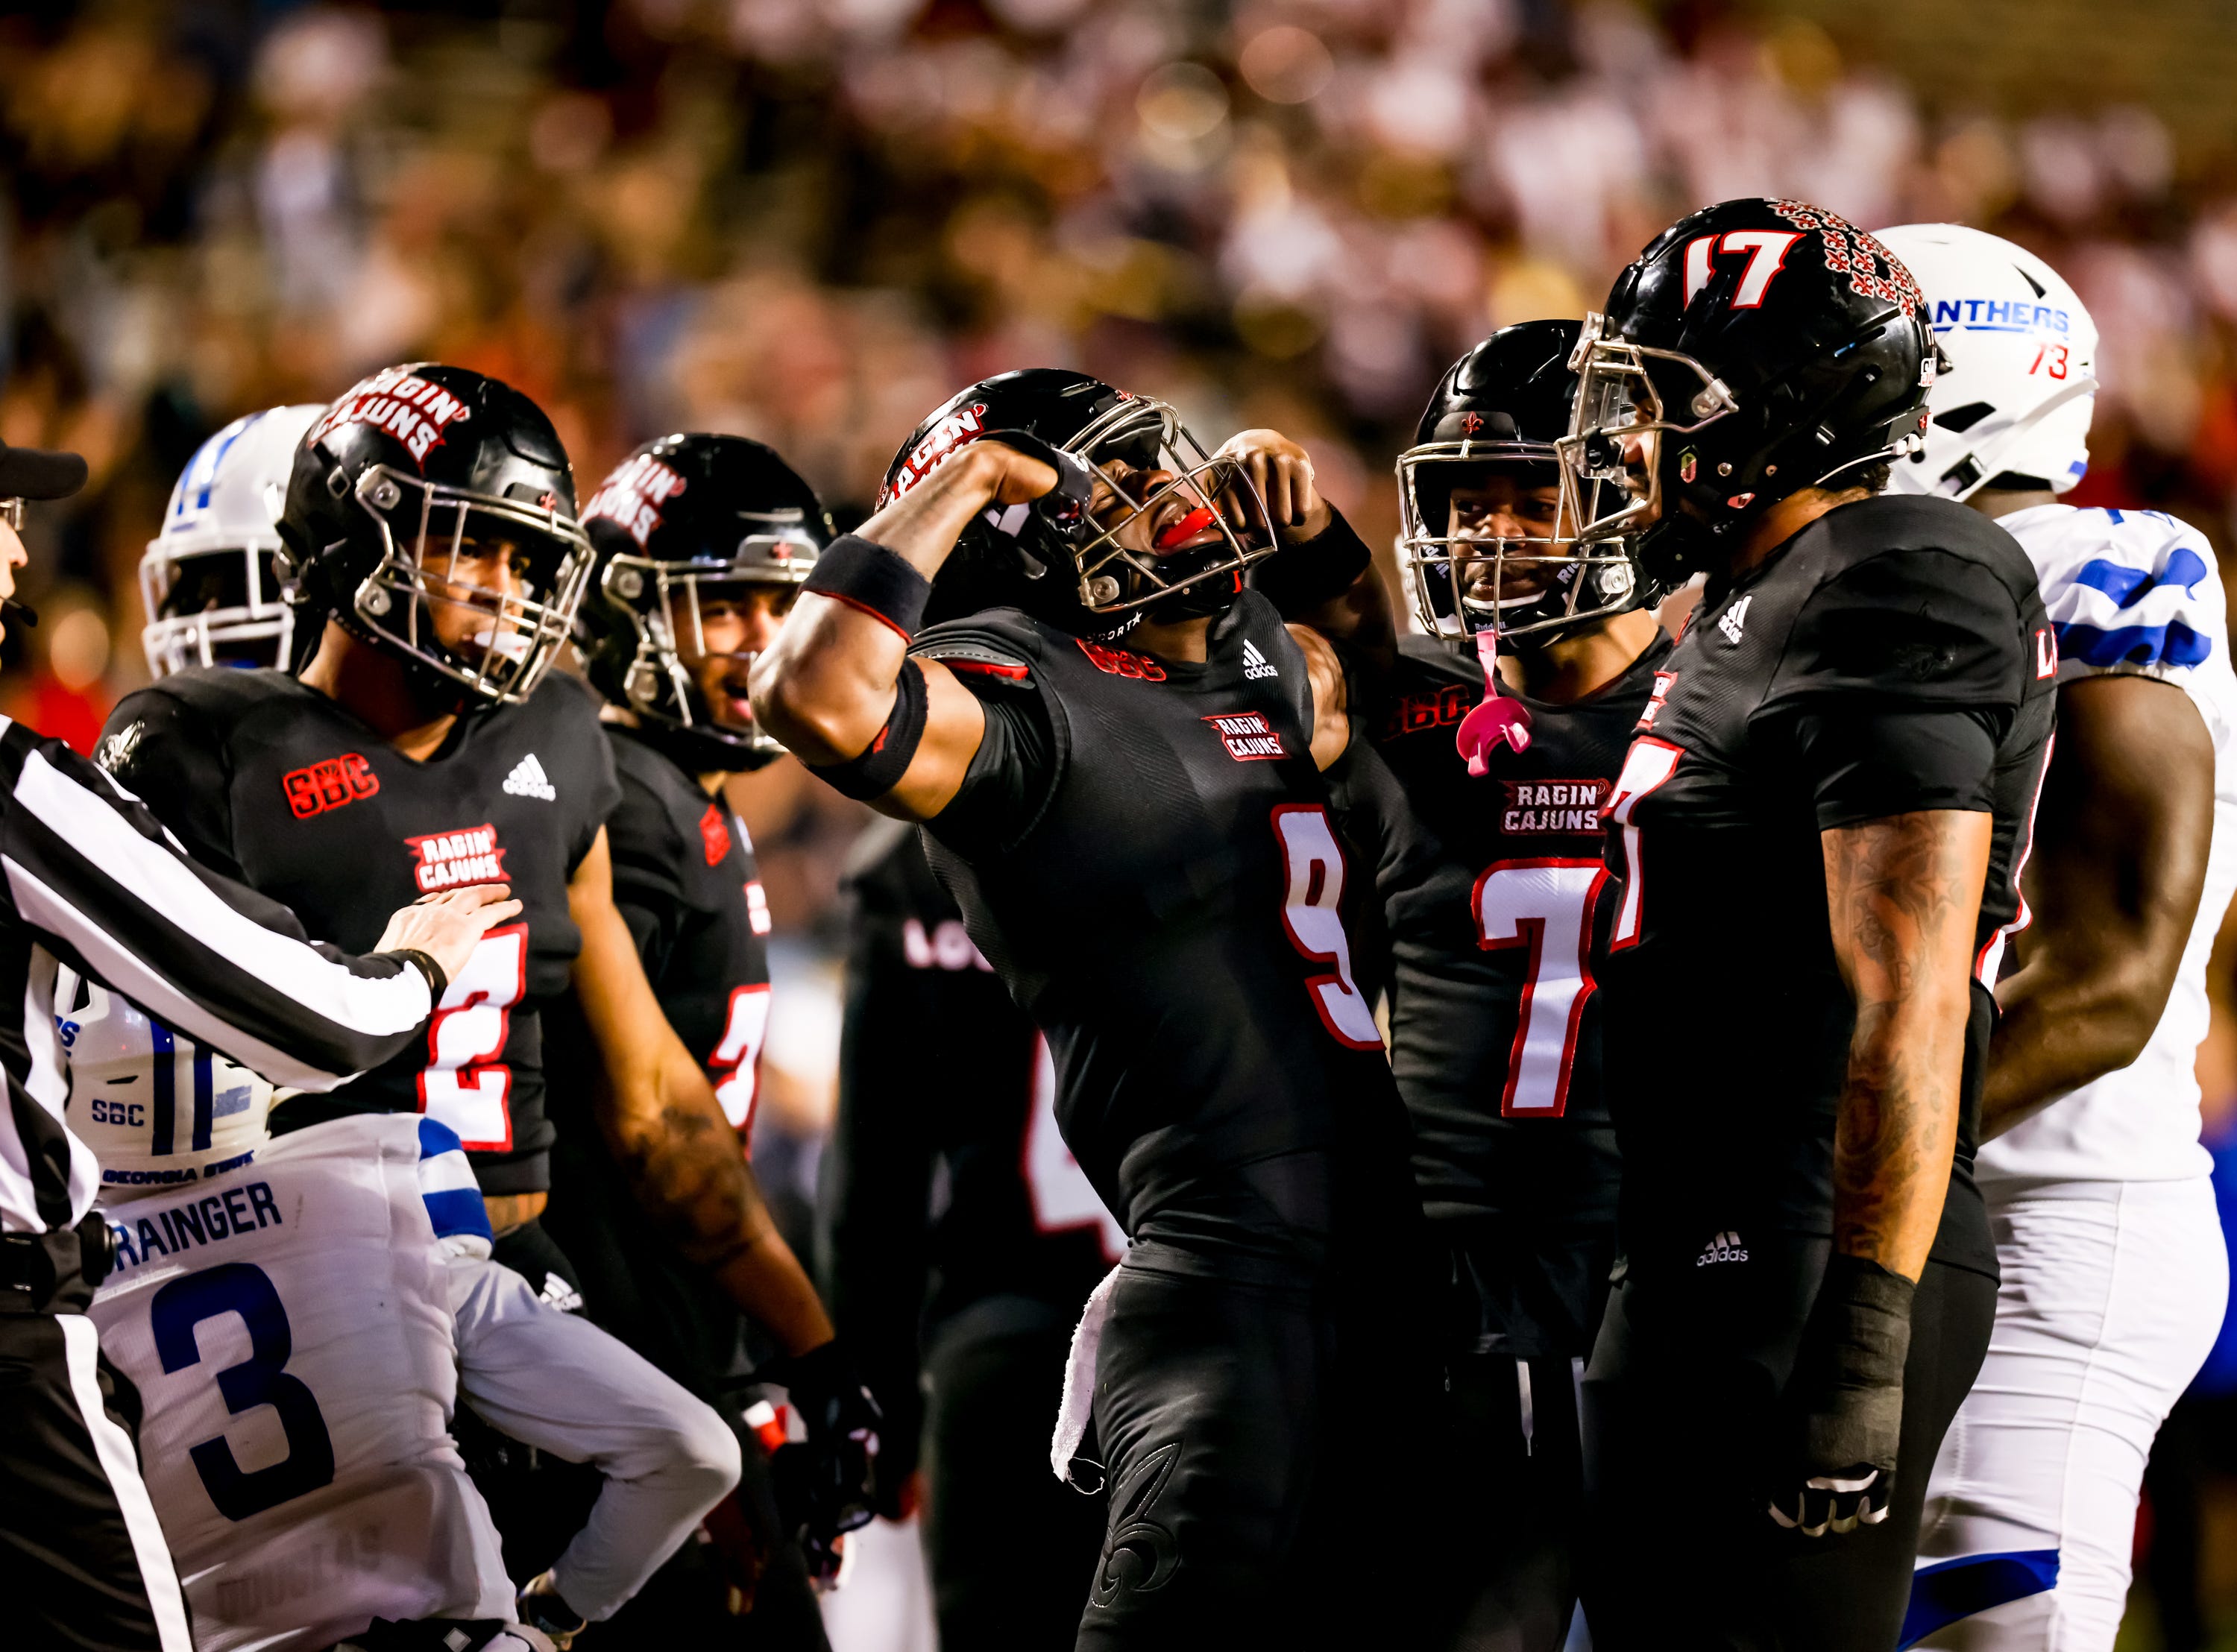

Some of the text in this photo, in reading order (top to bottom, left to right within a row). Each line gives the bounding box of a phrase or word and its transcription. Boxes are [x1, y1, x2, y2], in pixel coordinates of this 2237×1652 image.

[1684, 230, 1807, 312] 17
[2029, 342, 2069, 380] 73
[1226, 737, 1283, 757] CAJUNS
[283, 753, 380, 819] SBC
[1505, 810, 1599, 830] CAJUNS
[419, 854, 500, 889] CAJUNS
[1271, 802, 1386, 1051] 9
[1470, 857, 1613, 1117] 7
[416, 922, 529, 1152] 2
[92, 1099, 145, 1127] SBC
[102, 1168, 198, 1185] GEORGIA
[1696, 1246, 1749, 1267] adidas
[151, 1262, 336, 1522] 3
